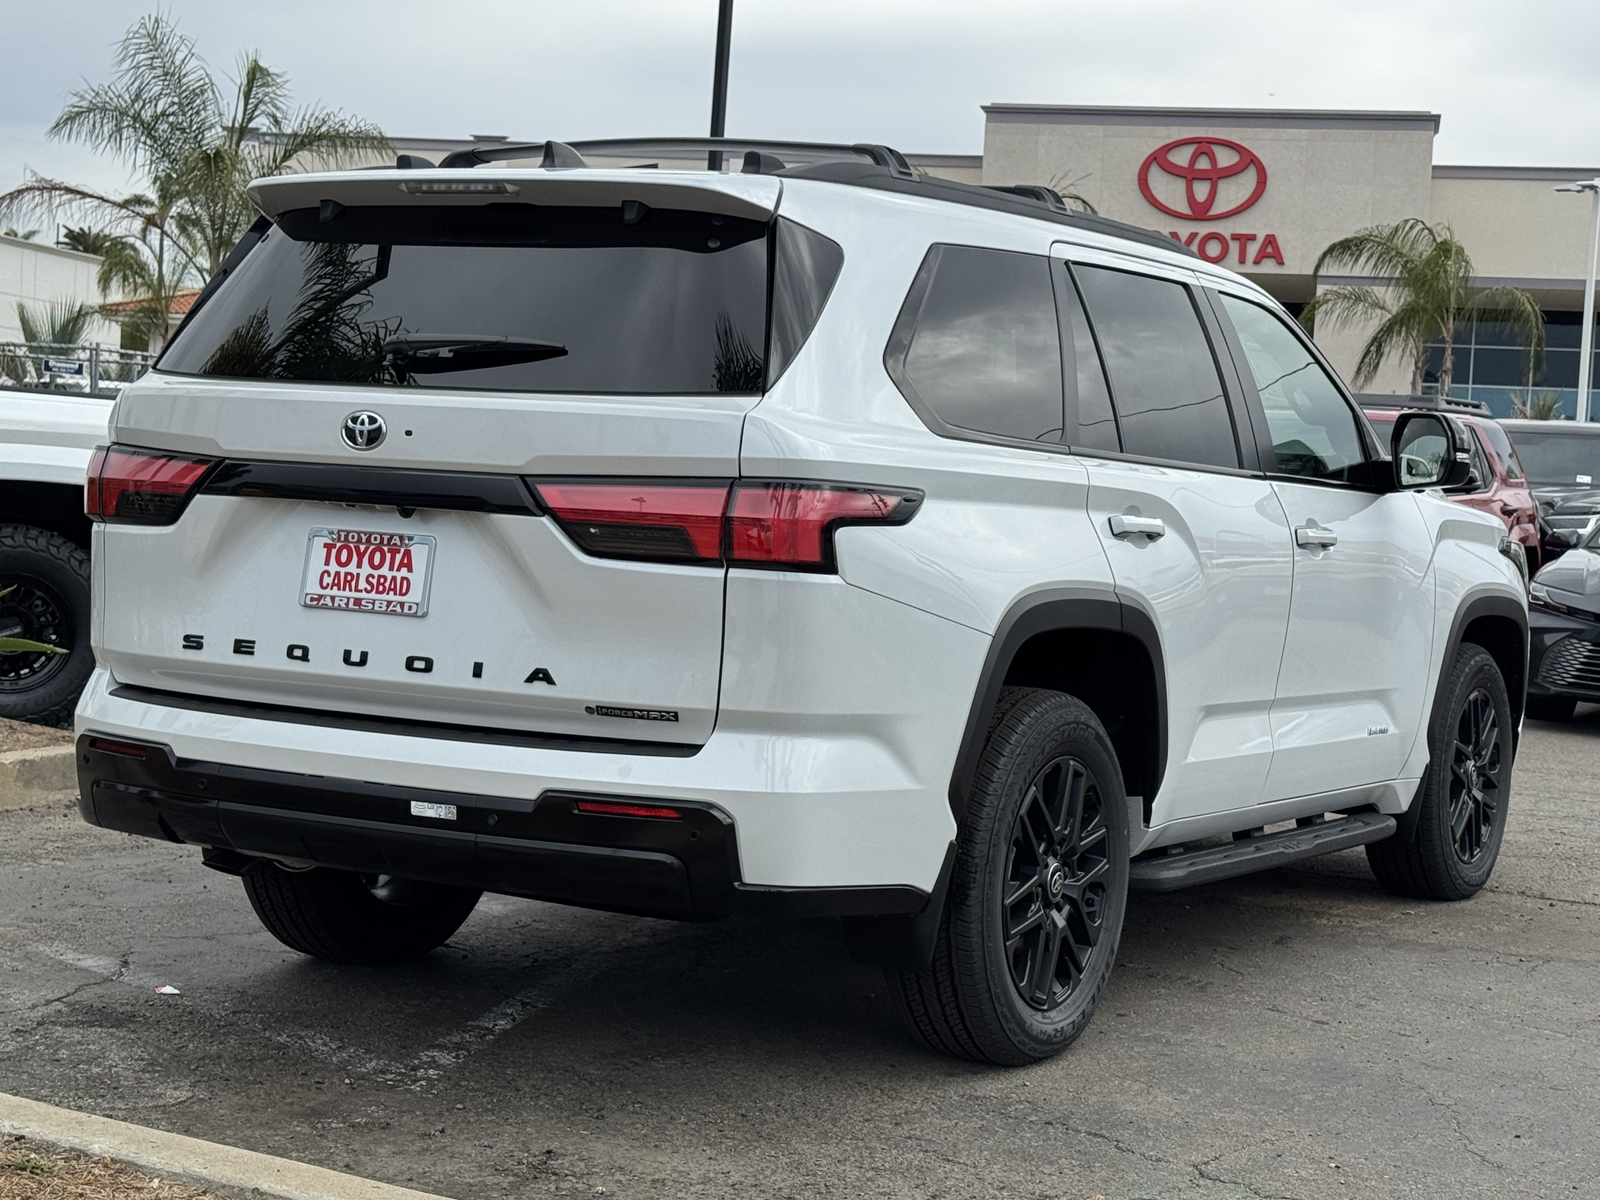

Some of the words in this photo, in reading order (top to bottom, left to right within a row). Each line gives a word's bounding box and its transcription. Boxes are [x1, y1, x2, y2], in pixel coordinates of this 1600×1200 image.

[1151, 230, 1285, 265] YOTA
[339, 531, 402, 546] TOYOTA
[323, 543, 414, 573] TOYOTA
[319, 570, 411, 597] CARLSBAD
[305, 594, 417, 614] CARLSBAD
[182, 633, 557, 686] SEQUOIA
